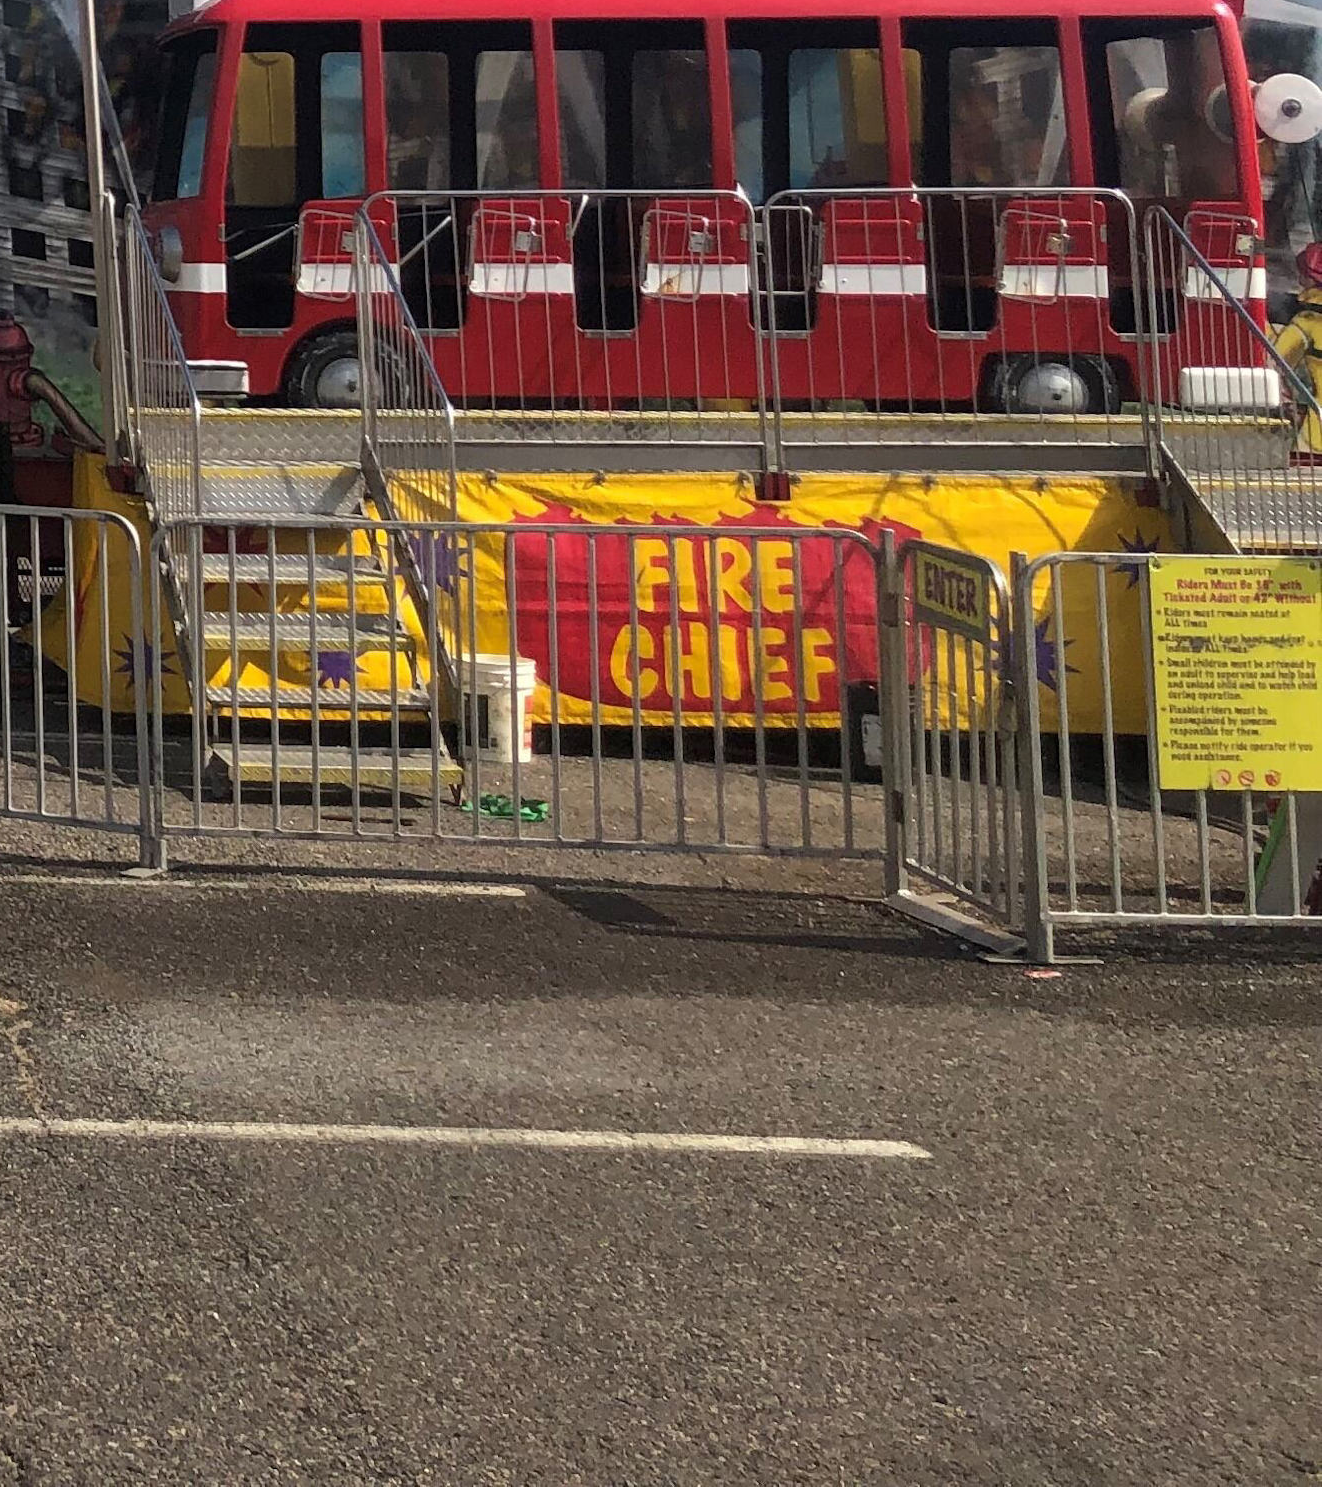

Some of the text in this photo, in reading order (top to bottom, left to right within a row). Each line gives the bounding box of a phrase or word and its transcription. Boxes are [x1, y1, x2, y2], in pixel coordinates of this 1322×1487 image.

[632, 537, 797, 613] FIRE
[1204, 568, 1271, 577] FOR YOUR SAFETY
[924, 561, 978, 617] ENTER
[1176, 579, 1208, 590] Riders
[1210, 579, 1237, 590] Must
[1240, 580, 1252, 590] Be
[1210, 592, 1237, 603] Adult
[1164, 608, 1191, 617] Riders
[1193, 609, 1214, 617] must
[1250, 609, 1278, 617] seated
[1164, 619, 1180, 627] ALL
[610, 622, 836, 702] CHIEF
[1167, 658, 1191, 667] Small
[1193, 658, 1228, 667] children
[1230, 660, 1251, 668] must
[1254, 659, 1263, 668] be
[1180, 670, 1202, 678] adult
[1217, 671, 1257, 680] supervise
[1269, 681, 1296, 689] watch
[1298, 681, 1317, 689] child
[1168, 692, 1196, 701] during
[1169, 705, 1268, 715] Disabled riders must be
[1228, 717, 1237, 726] by
[1169, 727, 1218, 736] responsible
[1221, 728, 1234, 736] for
[1170, 740, 1198, 750] Please
[1200, 741, 1228, 751] notify
[1230, 742, 1247, 750] ride
[1250, 742, 1287, 752] operator
[1171, 753, 1191, 761] need
